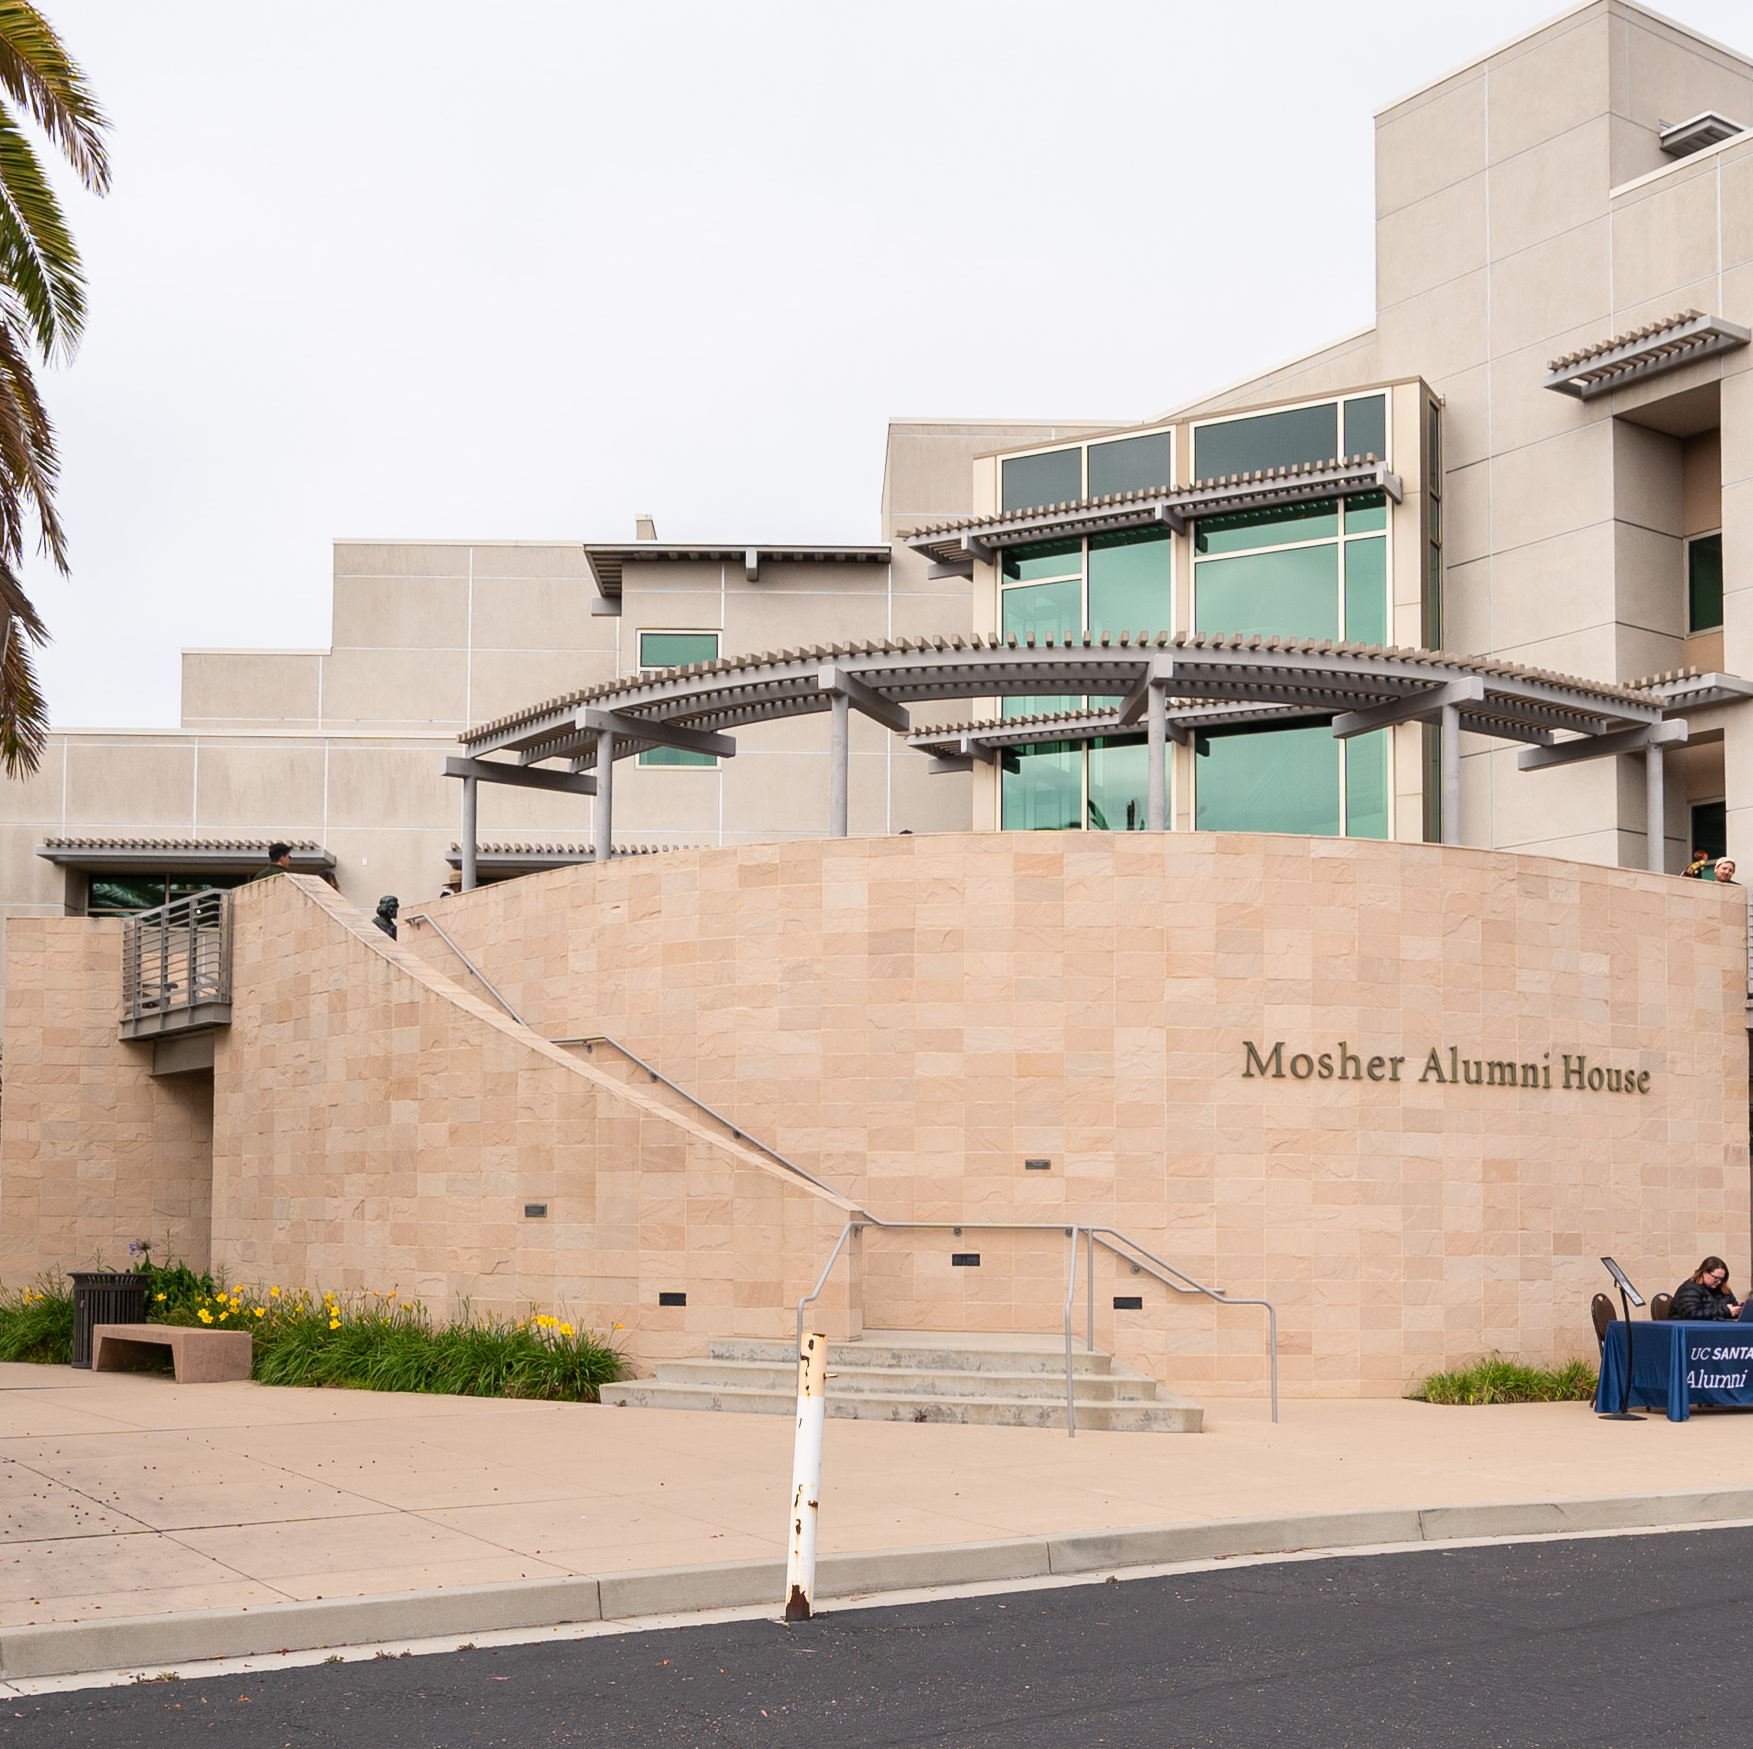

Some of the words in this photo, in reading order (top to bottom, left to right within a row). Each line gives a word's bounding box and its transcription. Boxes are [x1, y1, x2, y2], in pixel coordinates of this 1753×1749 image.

[1241, 1040, 1407, 1082] Mosher
[1417, 1045, 1552, 1089] Alumni
[1561, 1053, 1652, 1094] House
[1690, 1347, 1711, 1361] UC
[1686, 1368, 1749, 1389] Alumni
